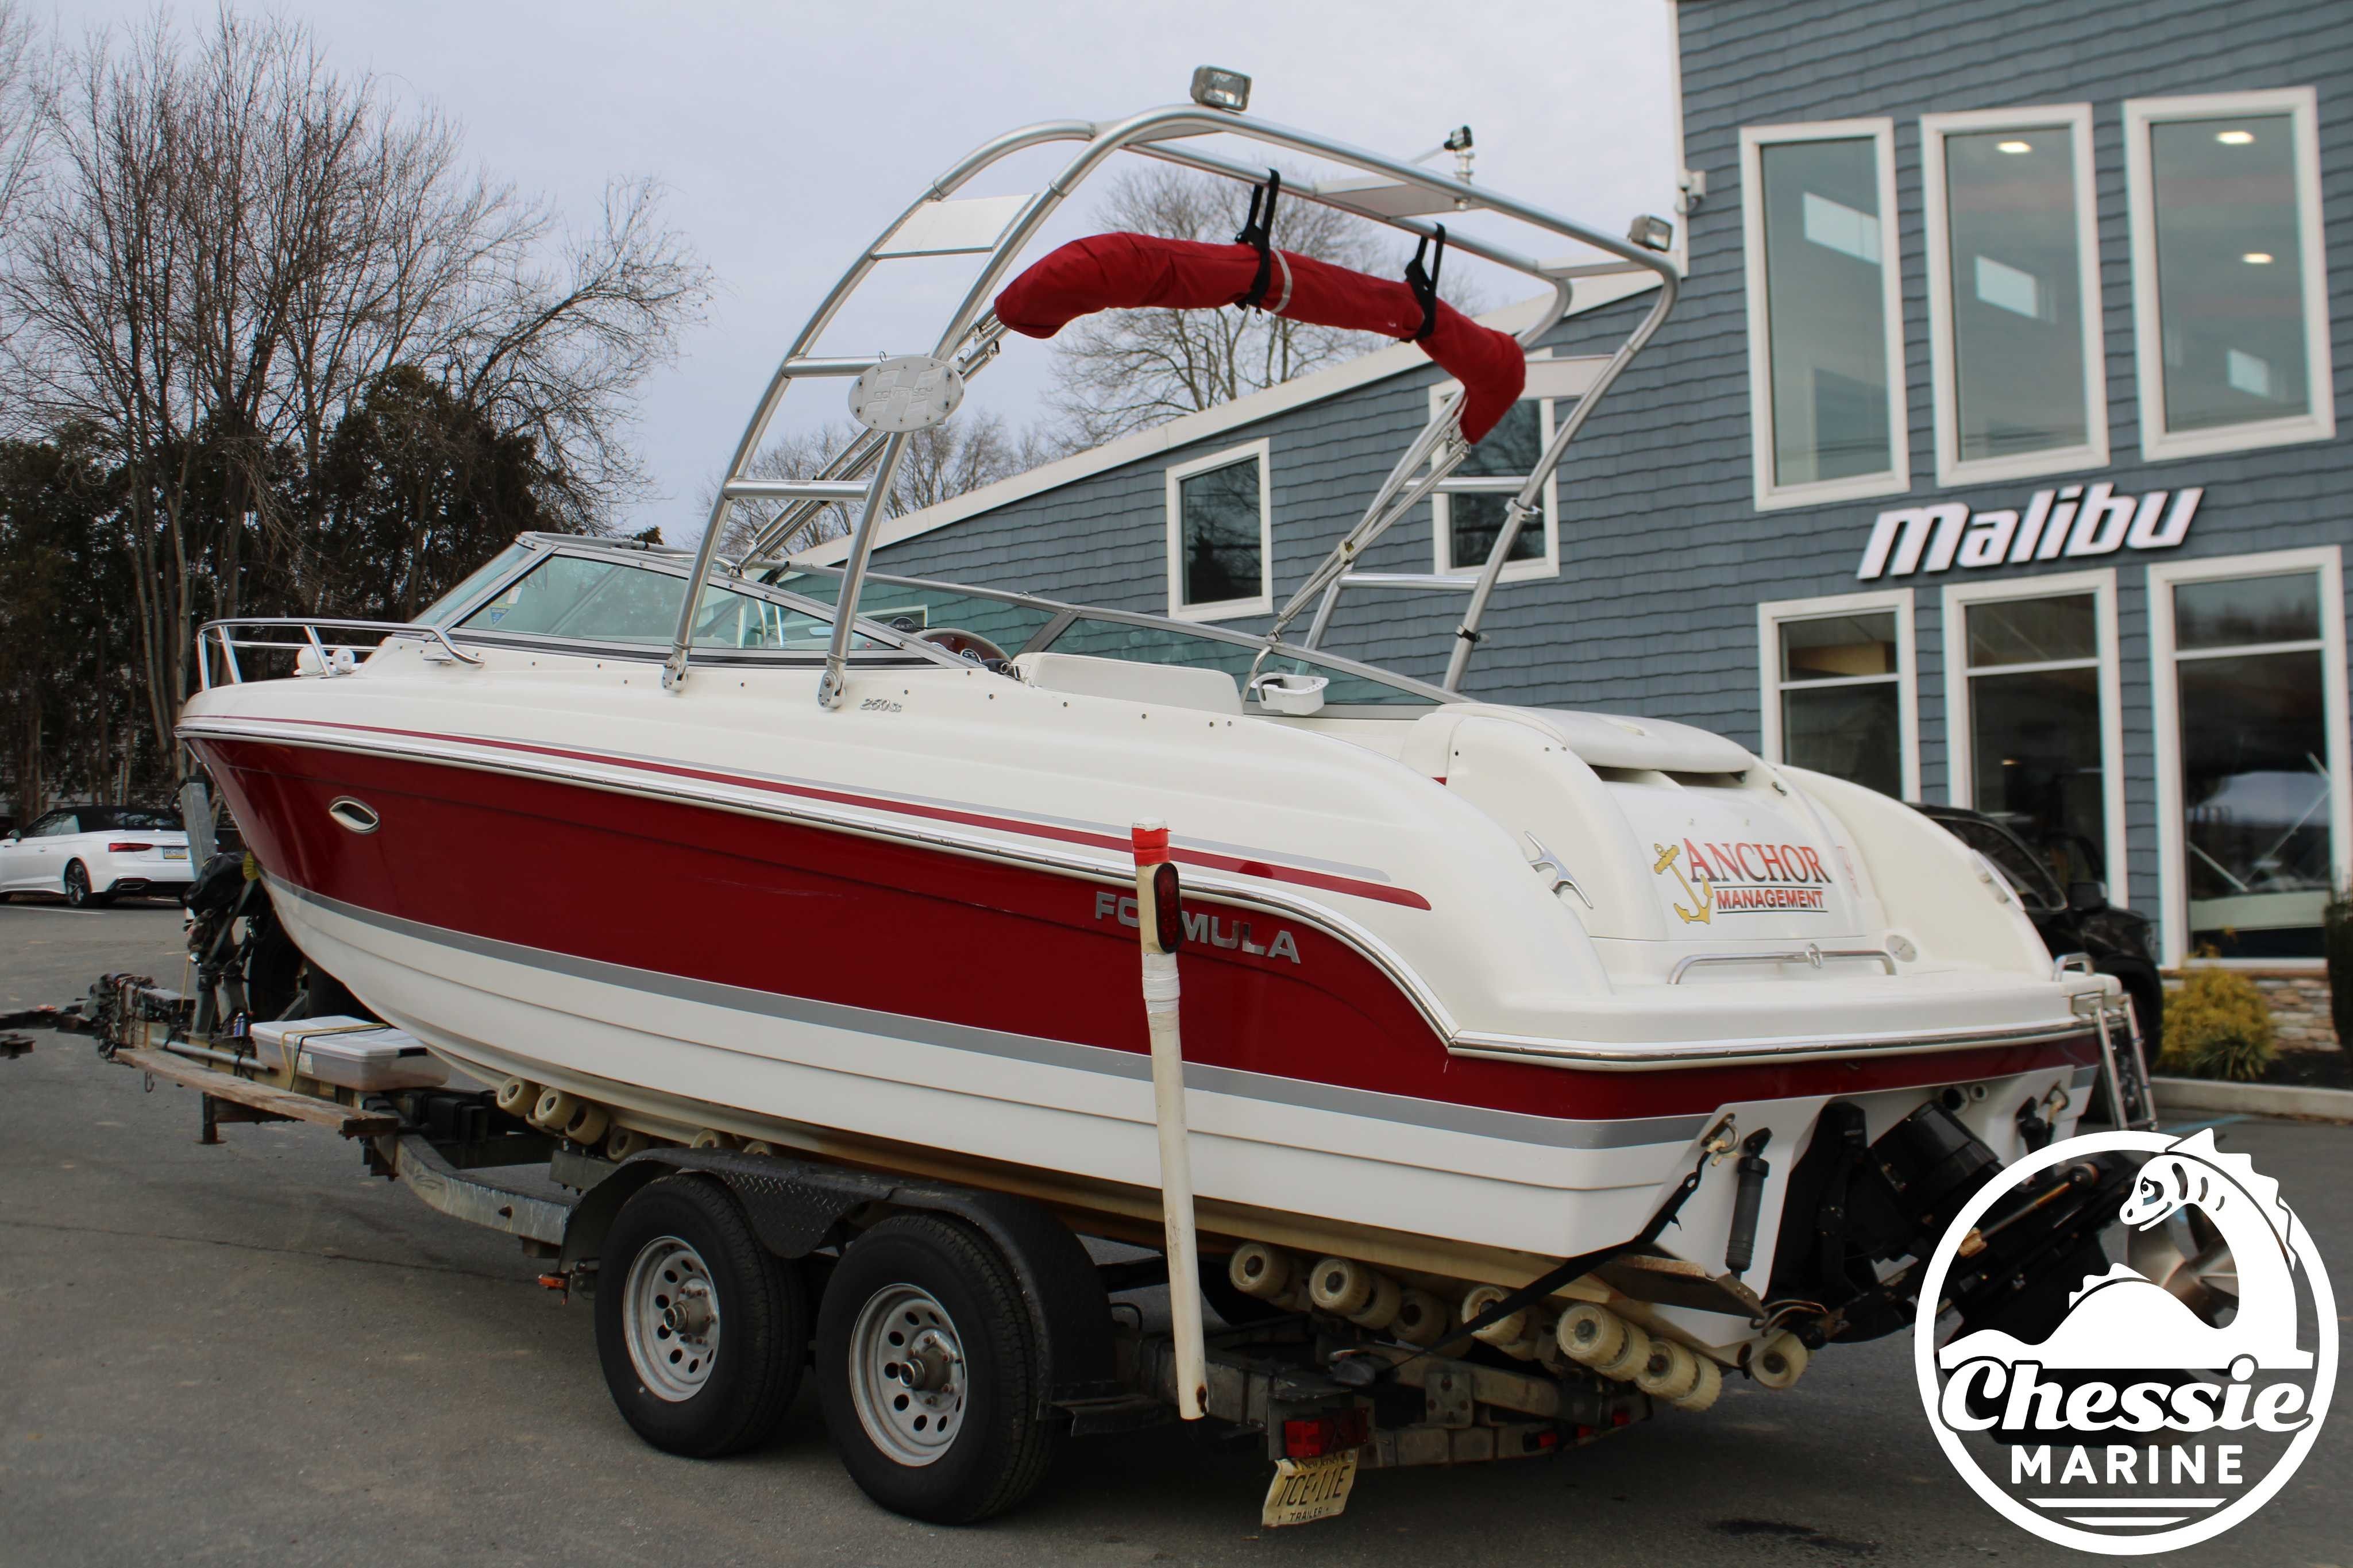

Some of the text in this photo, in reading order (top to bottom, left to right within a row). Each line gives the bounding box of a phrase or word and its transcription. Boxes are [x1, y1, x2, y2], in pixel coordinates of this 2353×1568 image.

[1857, 482, 2204, 580] Malibu
[1683, 838, 1833, 883] ANCHOR
[1716, 890, 1823, 909] MANAGEMENT
[1095, 891, 1301, 964] FOMULA
[1290, 1507, 1322, 1521] TRAILER
